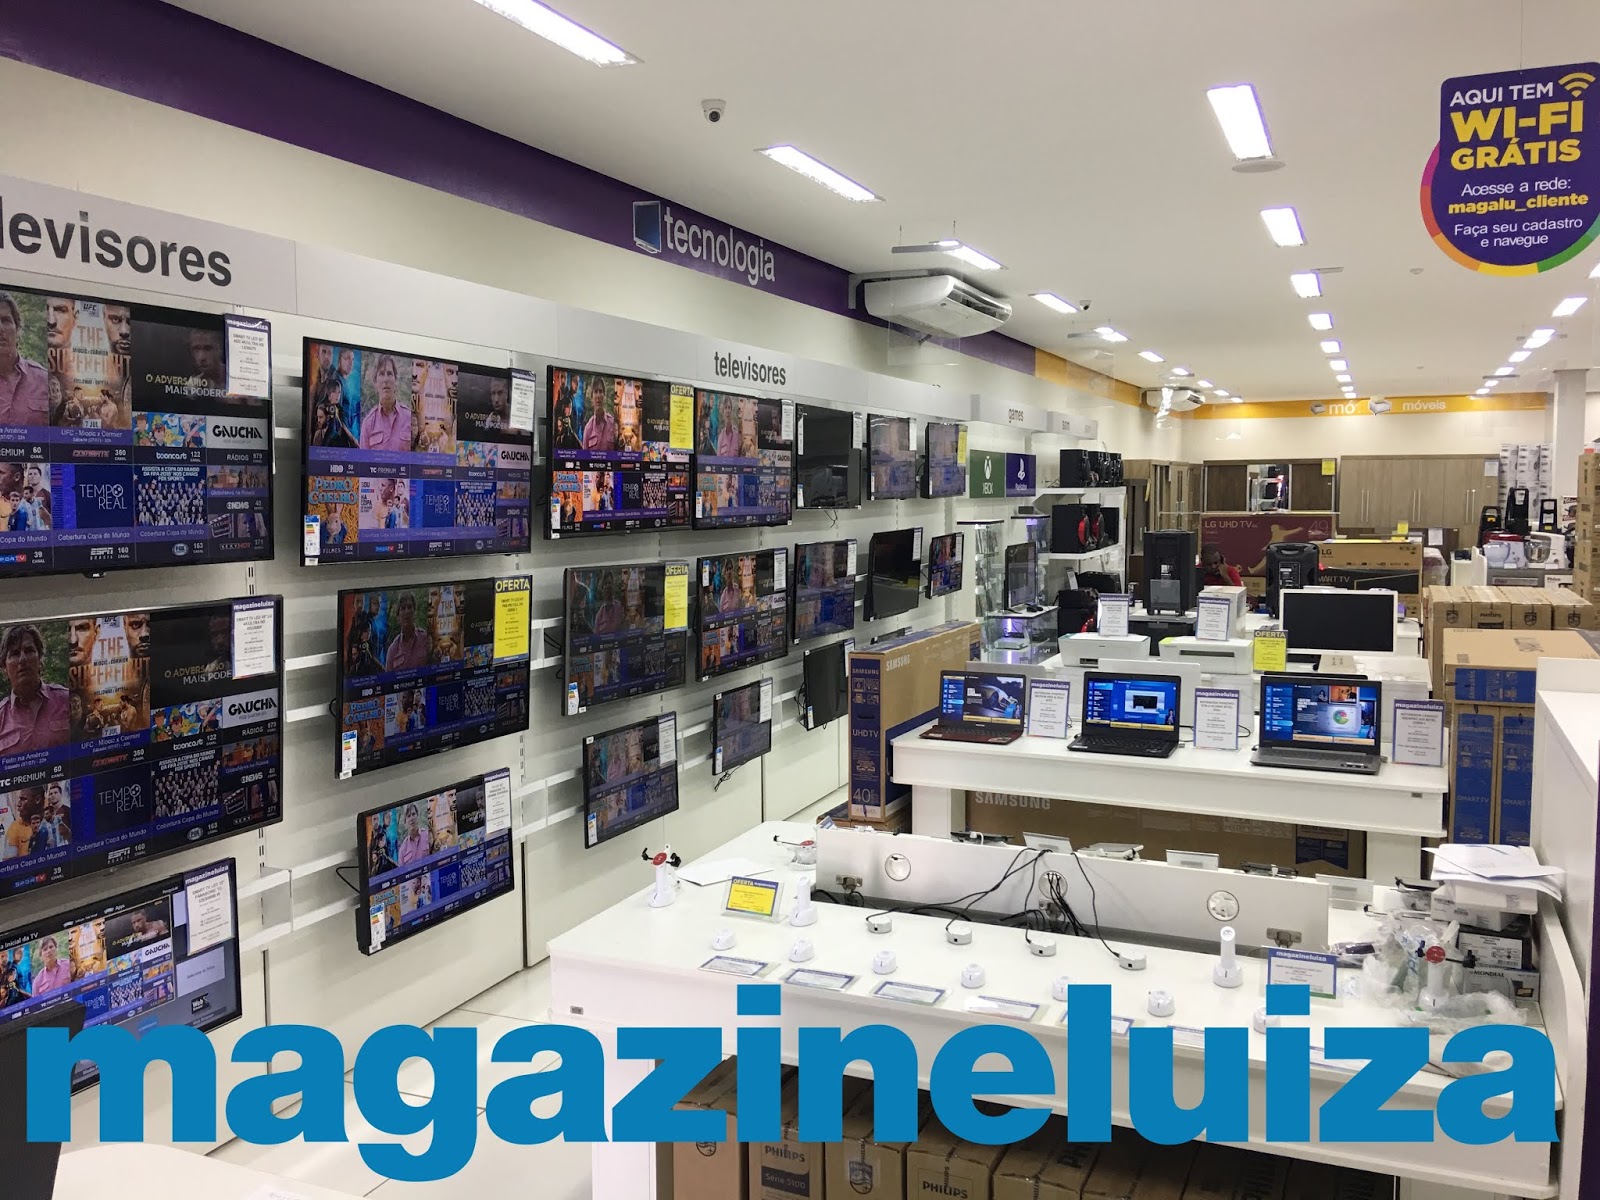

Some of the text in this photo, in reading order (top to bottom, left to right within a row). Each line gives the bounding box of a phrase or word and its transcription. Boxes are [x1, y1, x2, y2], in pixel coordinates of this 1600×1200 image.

[1450, 82, 1553, 106] AQUI TEM
[1450, 100, 1584, 143] WI-FI
[1451, 138, 1581, 171] GRÁTIS
[1461, 177, 1571, 197] Acesse a rede:
[1448, 193, 1588, 215] magalu_cliente
[1454, 217, 1583, 238] Faça seu cadastro
[664, 206, 775, 286] tecnologia
[1480, 234, 1548, 249] e navegue
[714, 351, 786, 386] televisores
[146, 374, 153, 382] O
[165, 384, 189, 396] MAIS
[671, 384, 694, 397] OFERTA
[1402, 400, 1447, 411] móveis
[1008, 408, 1024, 424] games
[227, 453, 249, 461] RÁDIOS
[330, 464, 344, 473] HBO
[79, 483, 124, 498] TEMPO
[98, 496, 127, 510] REAL
[1205, 520, 1251, 529] LG UHD TV
[91, 547, 113, 555] ESPN
[1322, 548, 1332, 556] LG
[665, 564, 689, 575] OFERTA
[495, 579, 530, 592] OFERTA
[1338, 575, 1350, 583] TV
[233, 601, 274, 611] magazineluiza
[1255, 630, 1286, 639] OFERTA
[886, 653, 910, 671] SAMSUNG
[164, 669, 171, 678] O
[183, 672, 207, 685] MAIS
[242, 726, 264, 736] RÁDIOS
[852, 729, 879, 738] UHD TV
[81, 741, 94, 749] UFC
[26, 751, 49, 760] América
[53, 765, 62, 773] 60
[0, 771, 46, 787] TC PREMIUM
[99, 783, 141, 806] TEMPO
[853, 788, 871, 803] 40
[975, 790, 1051, 810] SAMSUNG
[116, 796, 144, 813] REAL
[76, 842, 104, 853] Cobertura
[105, 837, 120, 846] Copa
[129, 829, 147, 838] Mundo
[20, 859, 36, 867] Copa
[47, 850, 67, 860] Mundo
[108, 847, 131, 859] ESPN
[53, 867, 62, 875] 39
[185, 865, 229, 884] magazineluiza
[1276, 951, 1327, 962] magazineluiza
[1474, 970, 1504, 978] MONDIAL
[765, 1145, 806, 1162] PHILIPS
[786, 1178, 806, 1190] 5100
[922, 1180, 968, 1198] PHILIPS
